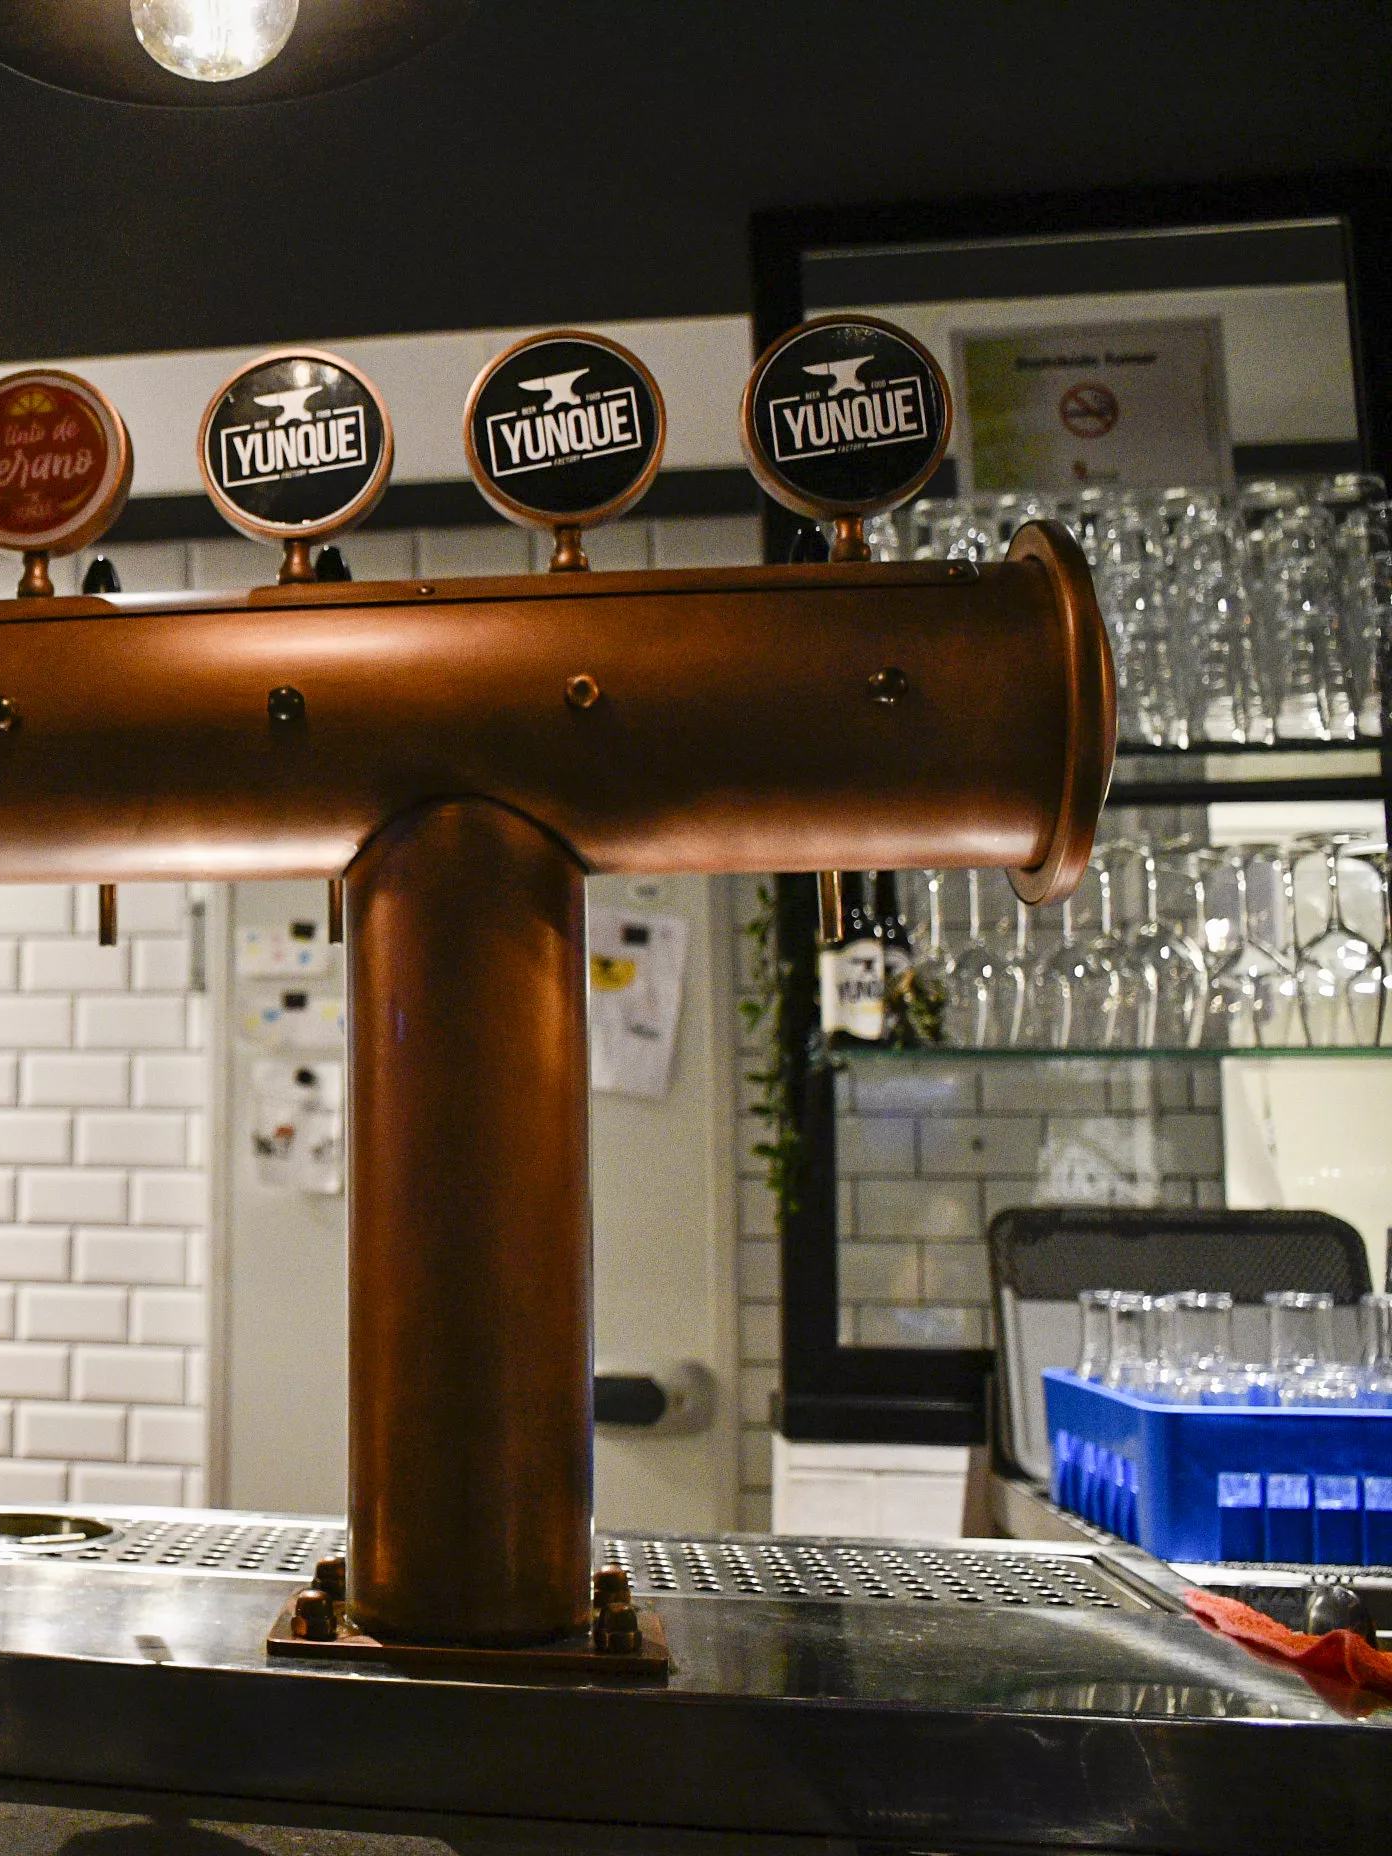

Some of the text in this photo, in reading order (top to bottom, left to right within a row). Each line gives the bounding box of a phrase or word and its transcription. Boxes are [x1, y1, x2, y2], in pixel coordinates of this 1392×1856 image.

[232, 415, 359, 477] YUNQUE
[499, 397, 633, 465] YUNQUE
[782, 387, 918, 450] YUNQUE
[837, 442, 867, 454] FACTORY
